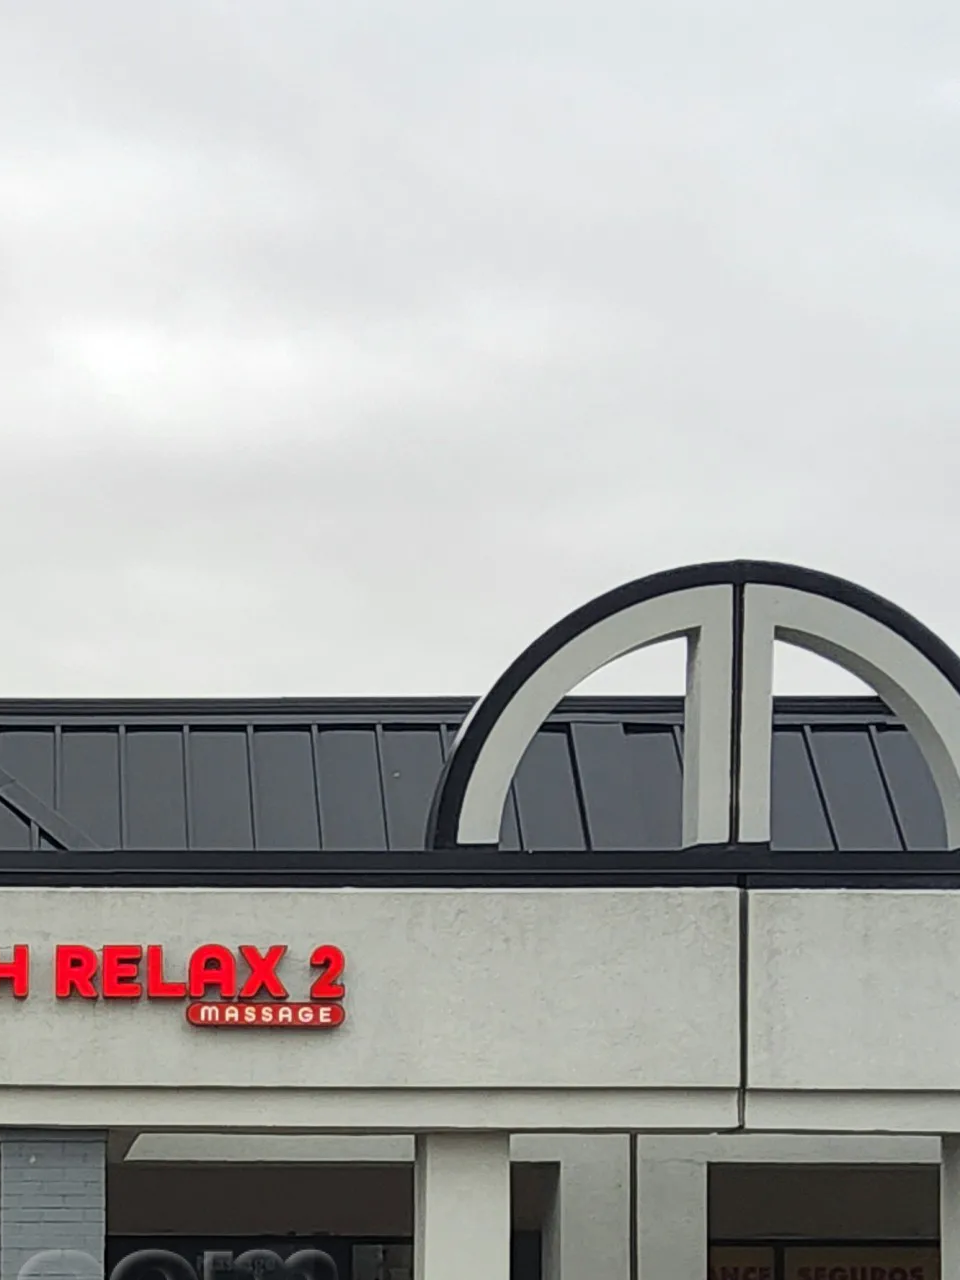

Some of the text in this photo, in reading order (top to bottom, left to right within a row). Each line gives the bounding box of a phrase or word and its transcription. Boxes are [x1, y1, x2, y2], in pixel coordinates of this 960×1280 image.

[55, 944, 289, 1000] RELAX
[308, 944, 346, 1000] 2
[199, 1006, 332, 1023] MASSAGE
